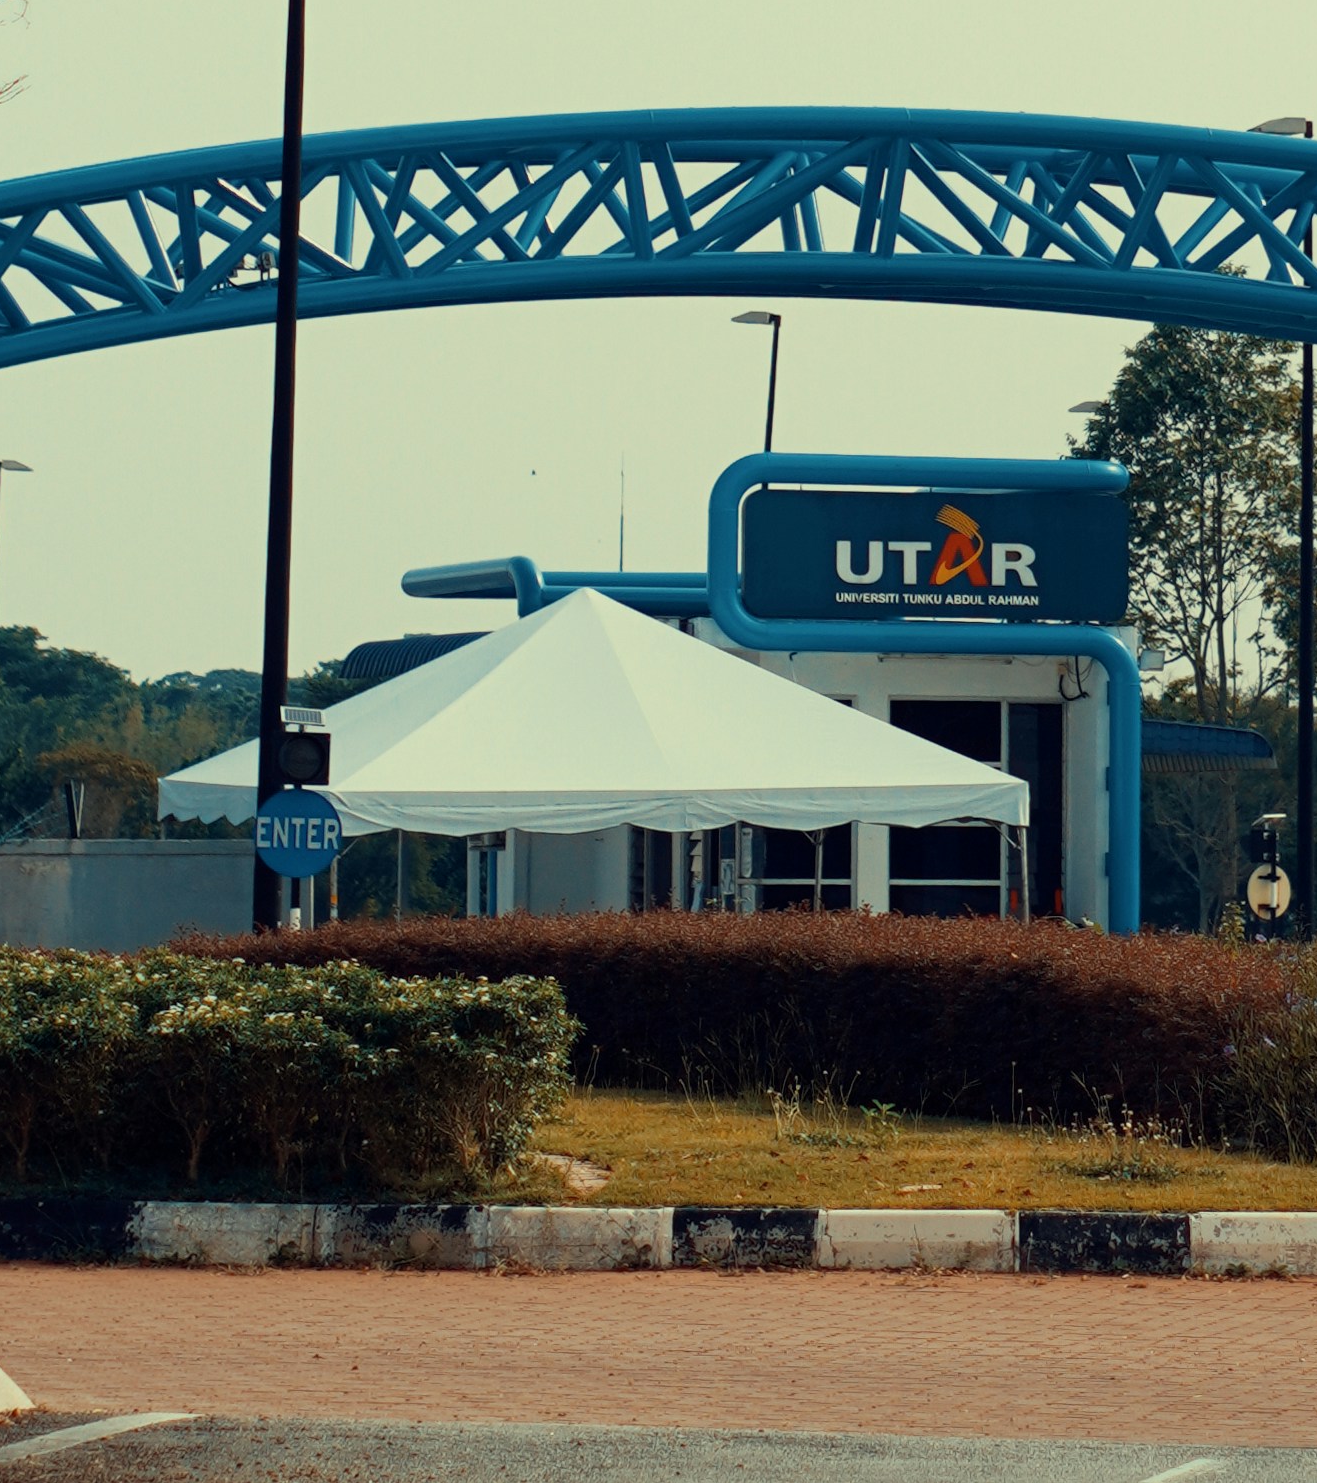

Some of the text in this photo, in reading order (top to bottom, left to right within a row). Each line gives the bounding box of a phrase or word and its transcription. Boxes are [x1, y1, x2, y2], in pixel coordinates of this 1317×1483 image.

[836, 532, 1038, 586] UTAR
[836, 592, 1039, 606] UNIVERSITI TUNKU ABDUL RAHMAN
[257, 816, 340, 849] ENTER
